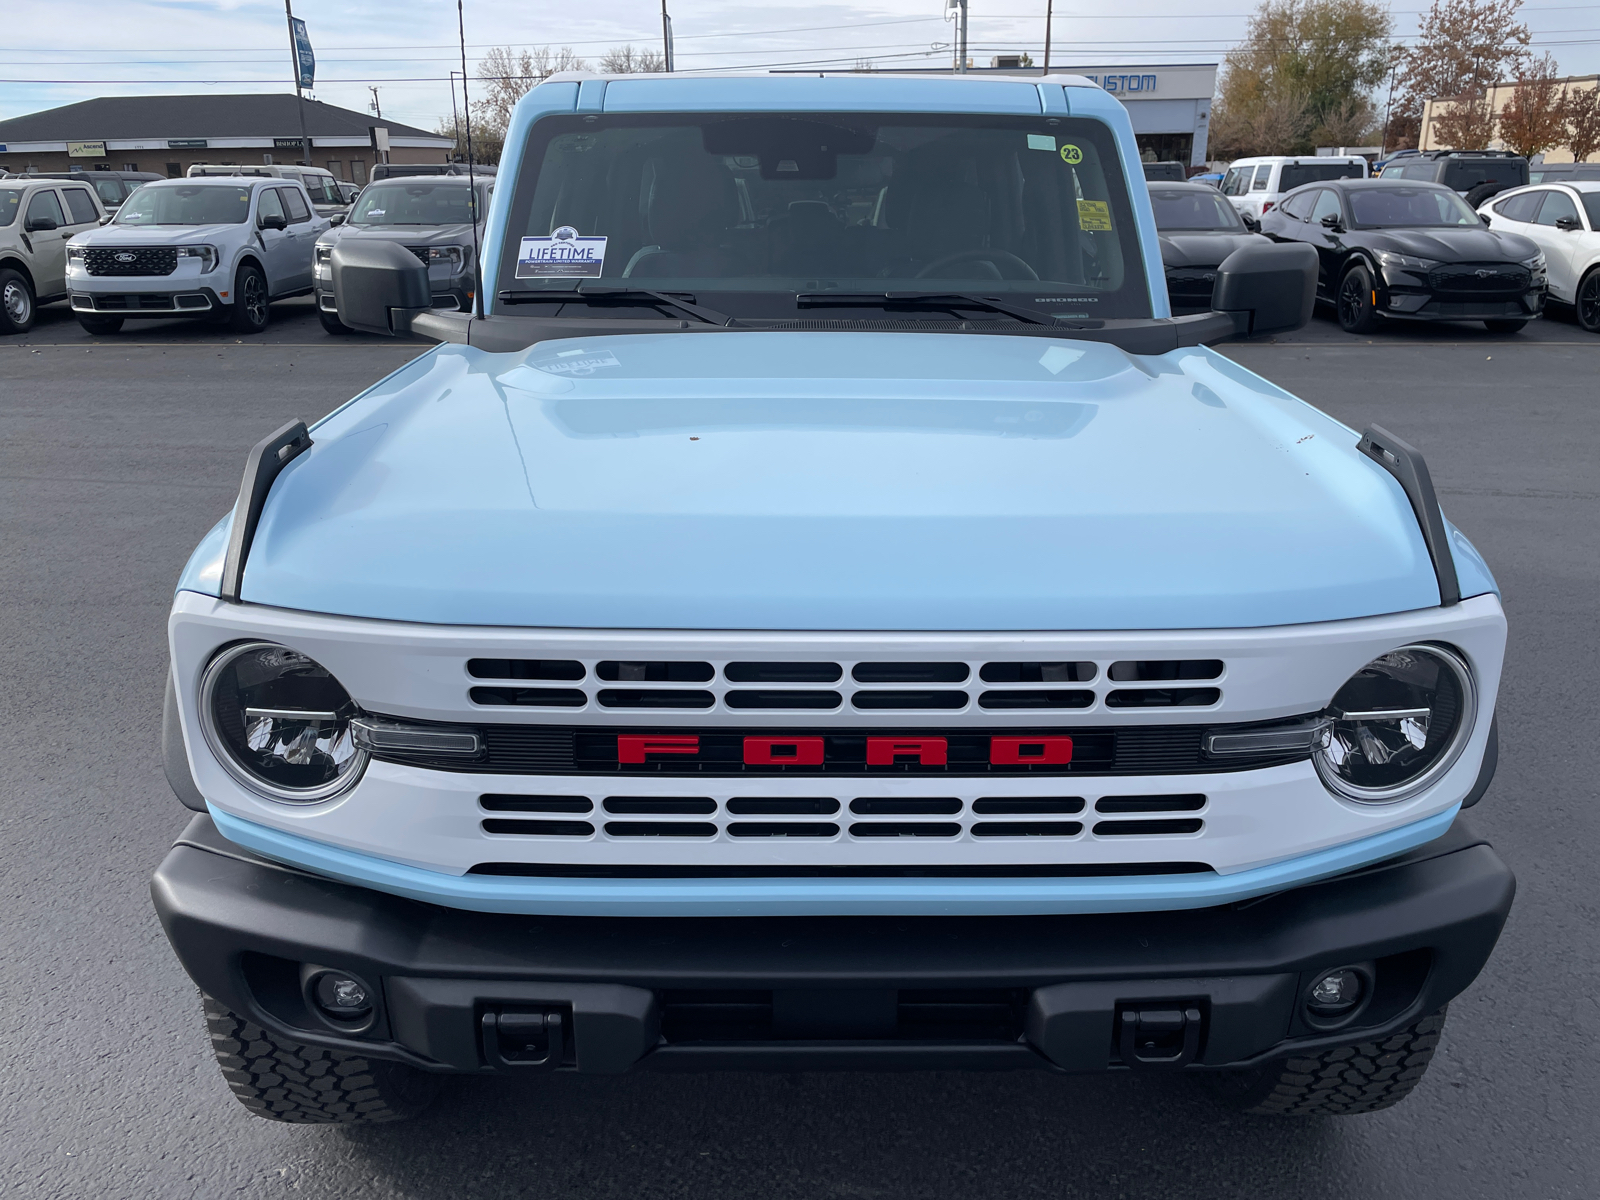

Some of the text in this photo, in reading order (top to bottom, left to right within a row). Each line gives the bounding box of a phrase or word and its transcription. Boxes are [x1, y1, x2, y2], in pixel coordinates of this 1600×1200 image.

[1063, 147, 1080, 160] 23
[528, 247, 594, 259] LIFETIME
[617, 734, 1073, 767] FORD
